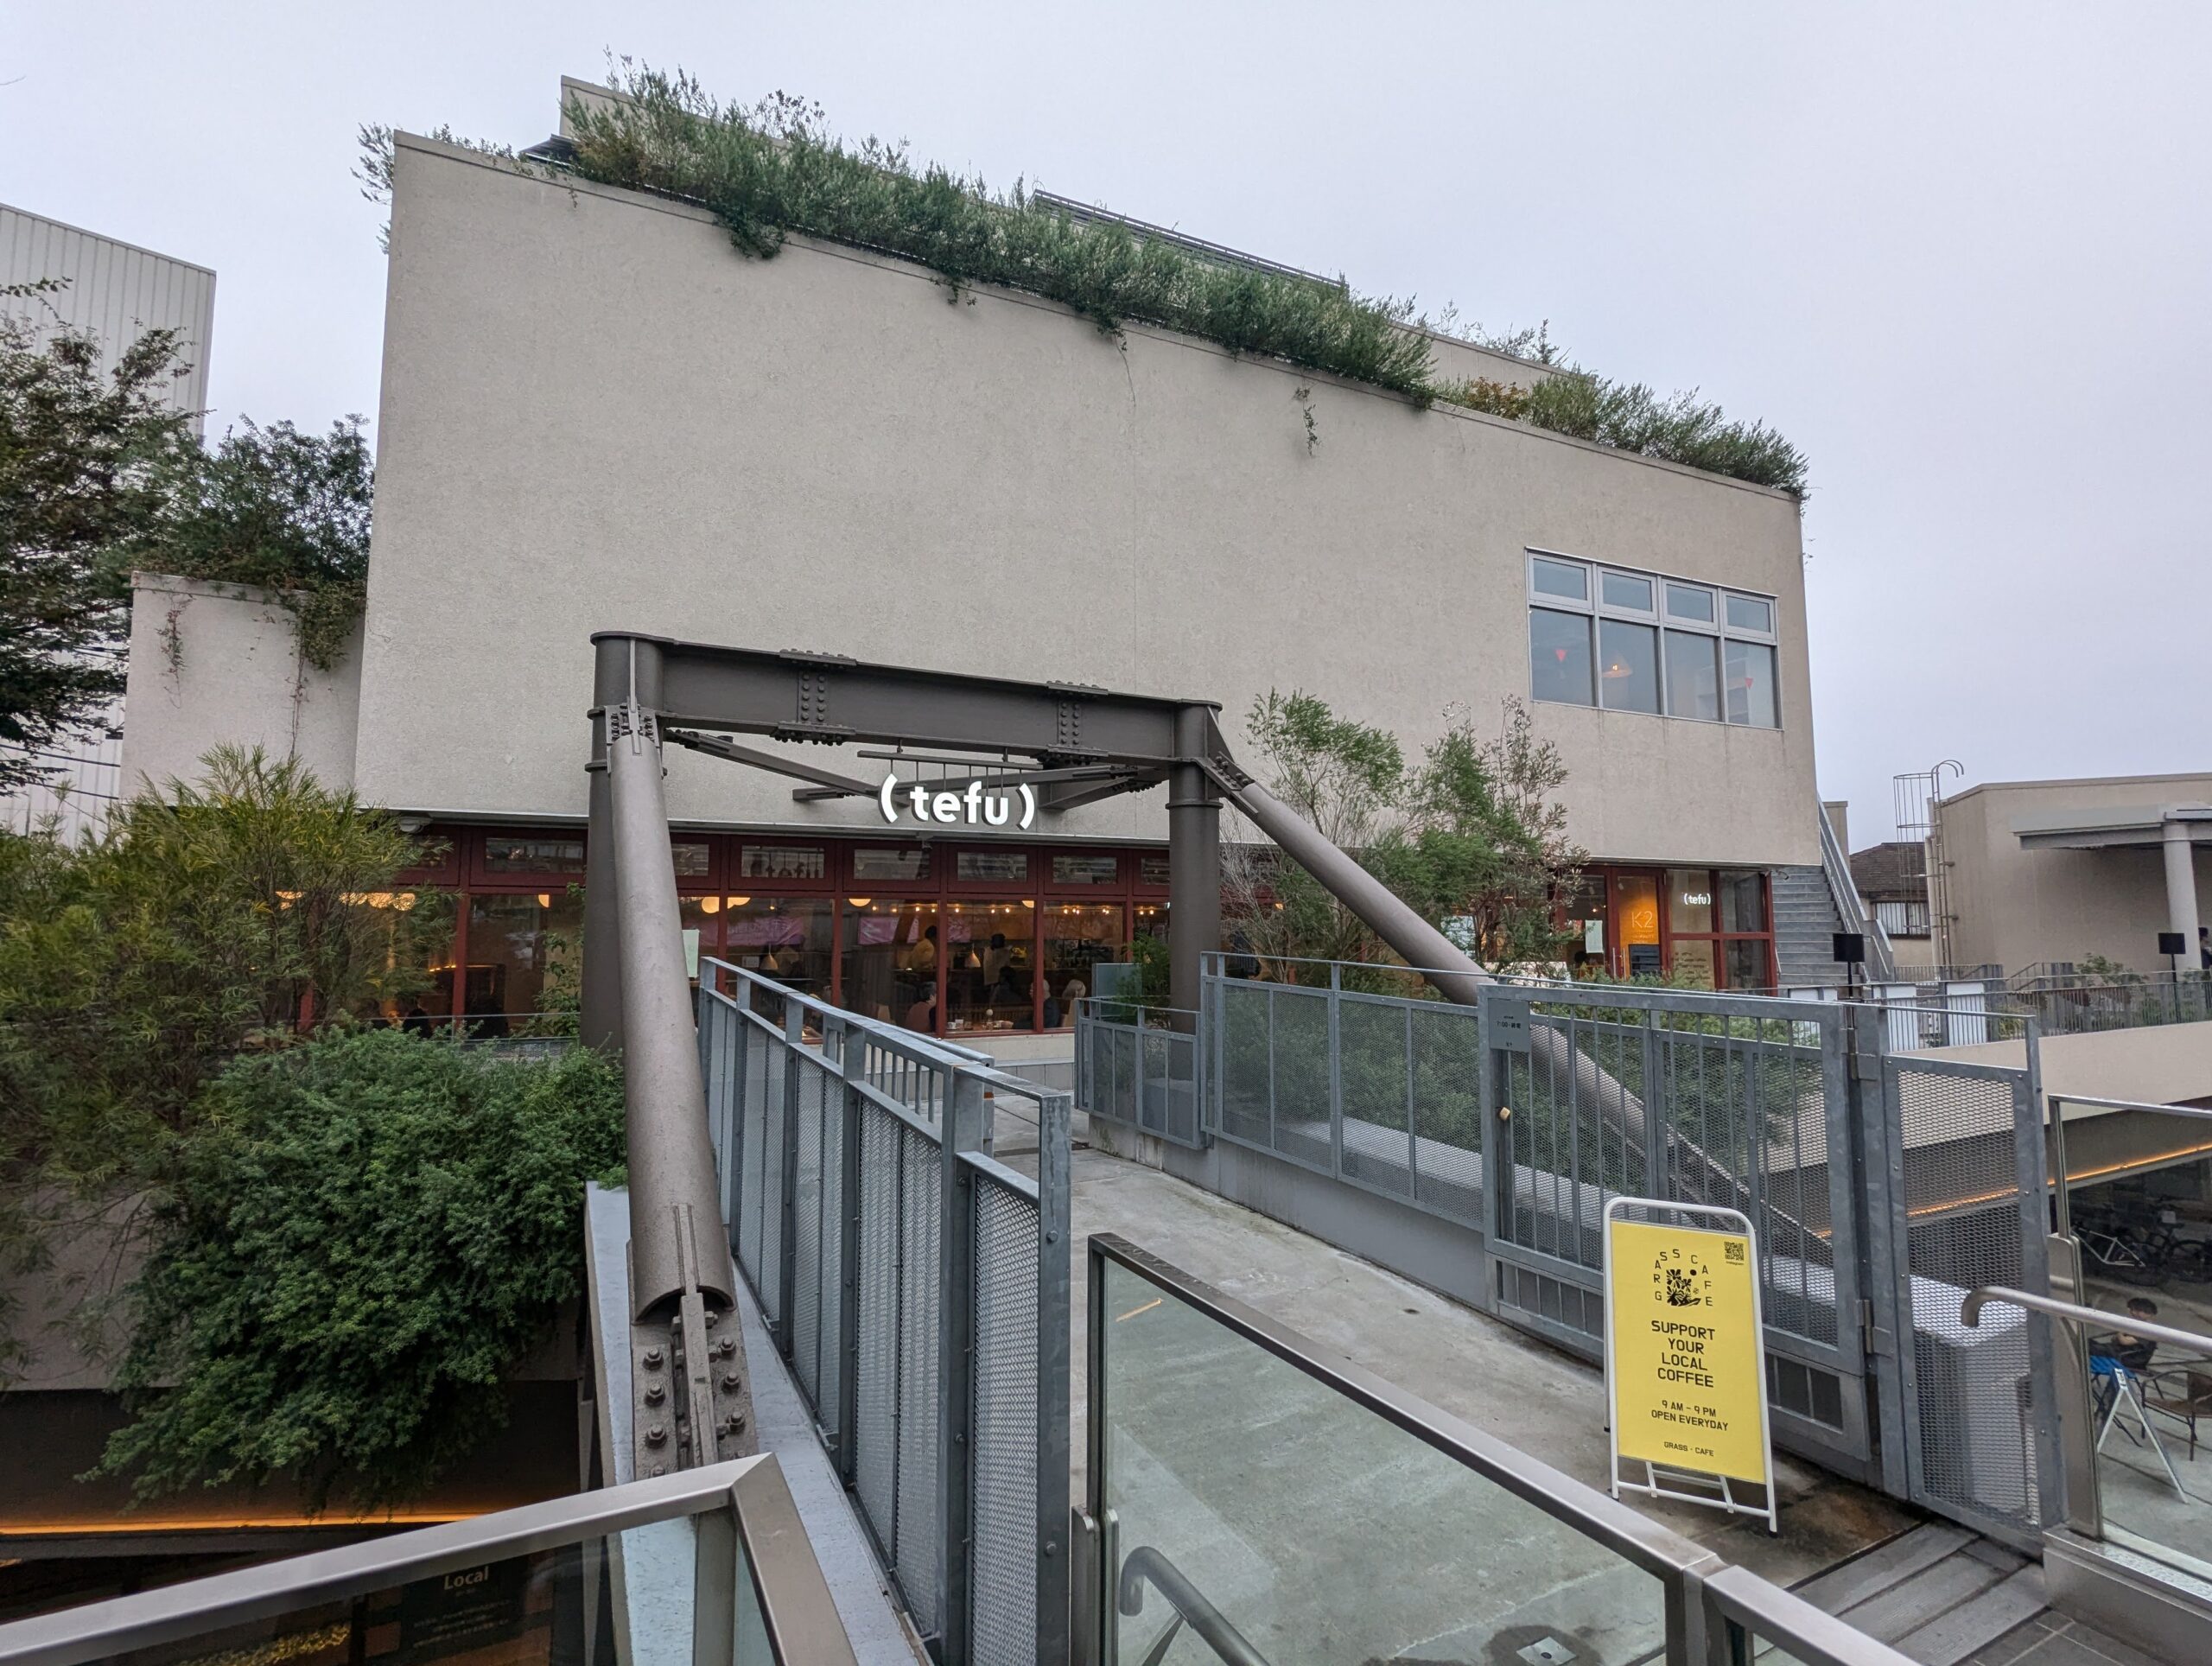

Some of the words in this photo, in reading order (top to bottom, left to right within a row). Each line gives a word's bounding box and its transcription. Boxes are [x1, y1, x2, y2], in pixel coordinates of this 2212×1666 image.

[879, 773, 1035, 830] (tefu)
[1683, 893, 1711, 905] (tefu)
[1631, 911, 1654, 928] K2
[1651, 1319, 1715, 1340] SUPPORT
[1668, 1338, 1704, 1354] YOUR
[1662, 1352, 1707, 1370] LOCAL
[1657, 1368, 1713, 1388] COFFEE
[1662, 1399, 1668, 1408] 9
[1670, 1402, 1683, 1411] AM
[1694, 1405, 1700, 1415] 9
[1702, 1407, 1716, 1417] PM
[1651, 1409, 1676, 1422] OPEN
[1679, 1415, 1728, 1431] EVERYDAY
[1663, 1441, 1688, 1452] GRASS
[1694, 1447, 1714, 1457] CAFE
[443, 1566, 490, 1590] Local
